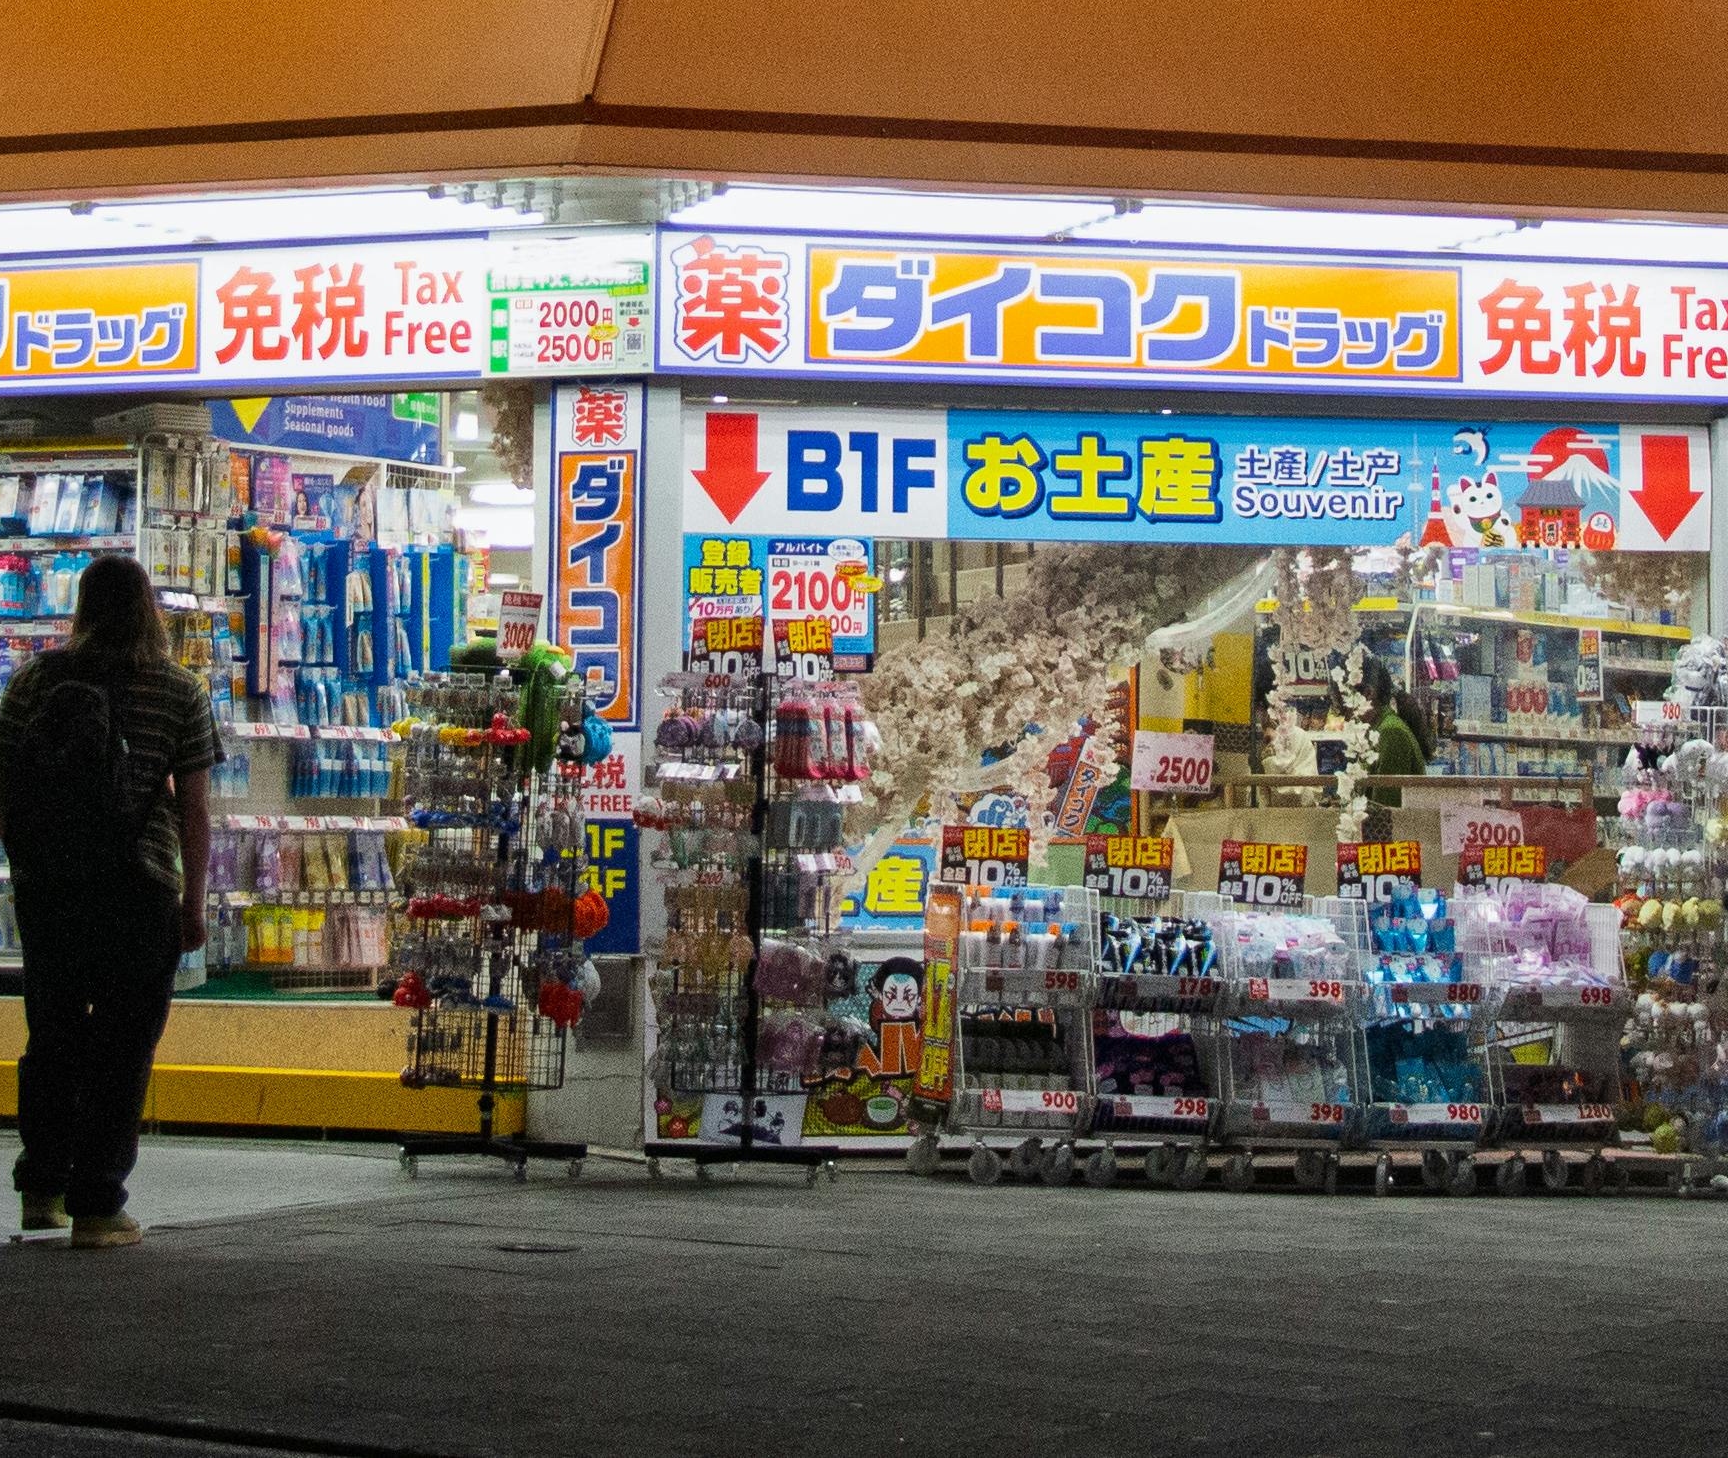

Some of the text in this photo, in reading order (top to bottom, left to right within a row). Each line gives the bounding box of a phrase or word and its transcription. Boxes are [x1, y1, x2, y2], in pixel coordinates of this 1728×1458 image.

[215, 260, 369, 366] 免税
[394, 259, 465, 306] Tax
[674, 235, 789, 362] 薬
[1478, 278, 1647, 378] 免税
[384, 309, 472, 354] Free
[284, 400, 345, 420] Supplements
[573, 384, 625, 446] 薬
[284, 418, 355, 438] Seasonal goods
[786, 430, 1217, 520] B1F お土産
[1232, 485, 1403, 520] Souvenir
[702, 539, 751, 567] 登録
[775, 542, 824, 554] アルバイト
[570, 460, 626, 714] ダイコク
[690, 568, 762, 595] 販売者
[707, 619, 754, 651] 閉店
[704, 674, 731, 688] 600
[1662, 703, 1681, 720] 980
[1155, 757, 1210, 787] 2500
[963, 828, 1018, 860] 閉店
[1465, 822, 1522, 847] 3000
[1107, 836, 1162, 868] 閉店
[1241, 843, 1295, 875] 閉店
[1357, 842, 1410, 874] 閉店
[1483, 846, 1536, 877] 閉店
[1147, 884, 1170, 898] OFF
[1280, 890, 1303, 905] OFF
[1044, 971, 1079, 991] 598
[1177, 978, 1213, 997] 178
[1308, 981, 1342, 998] 398
[1579, 987, 1611, 1005] 698
[1041, 1091, 1077, 1109] 900
[1173, 1097, 1208, 1116] 298
[1310, 1105, 1343, 1123] 398
[1446, 1105, 1480, 1123] 980
